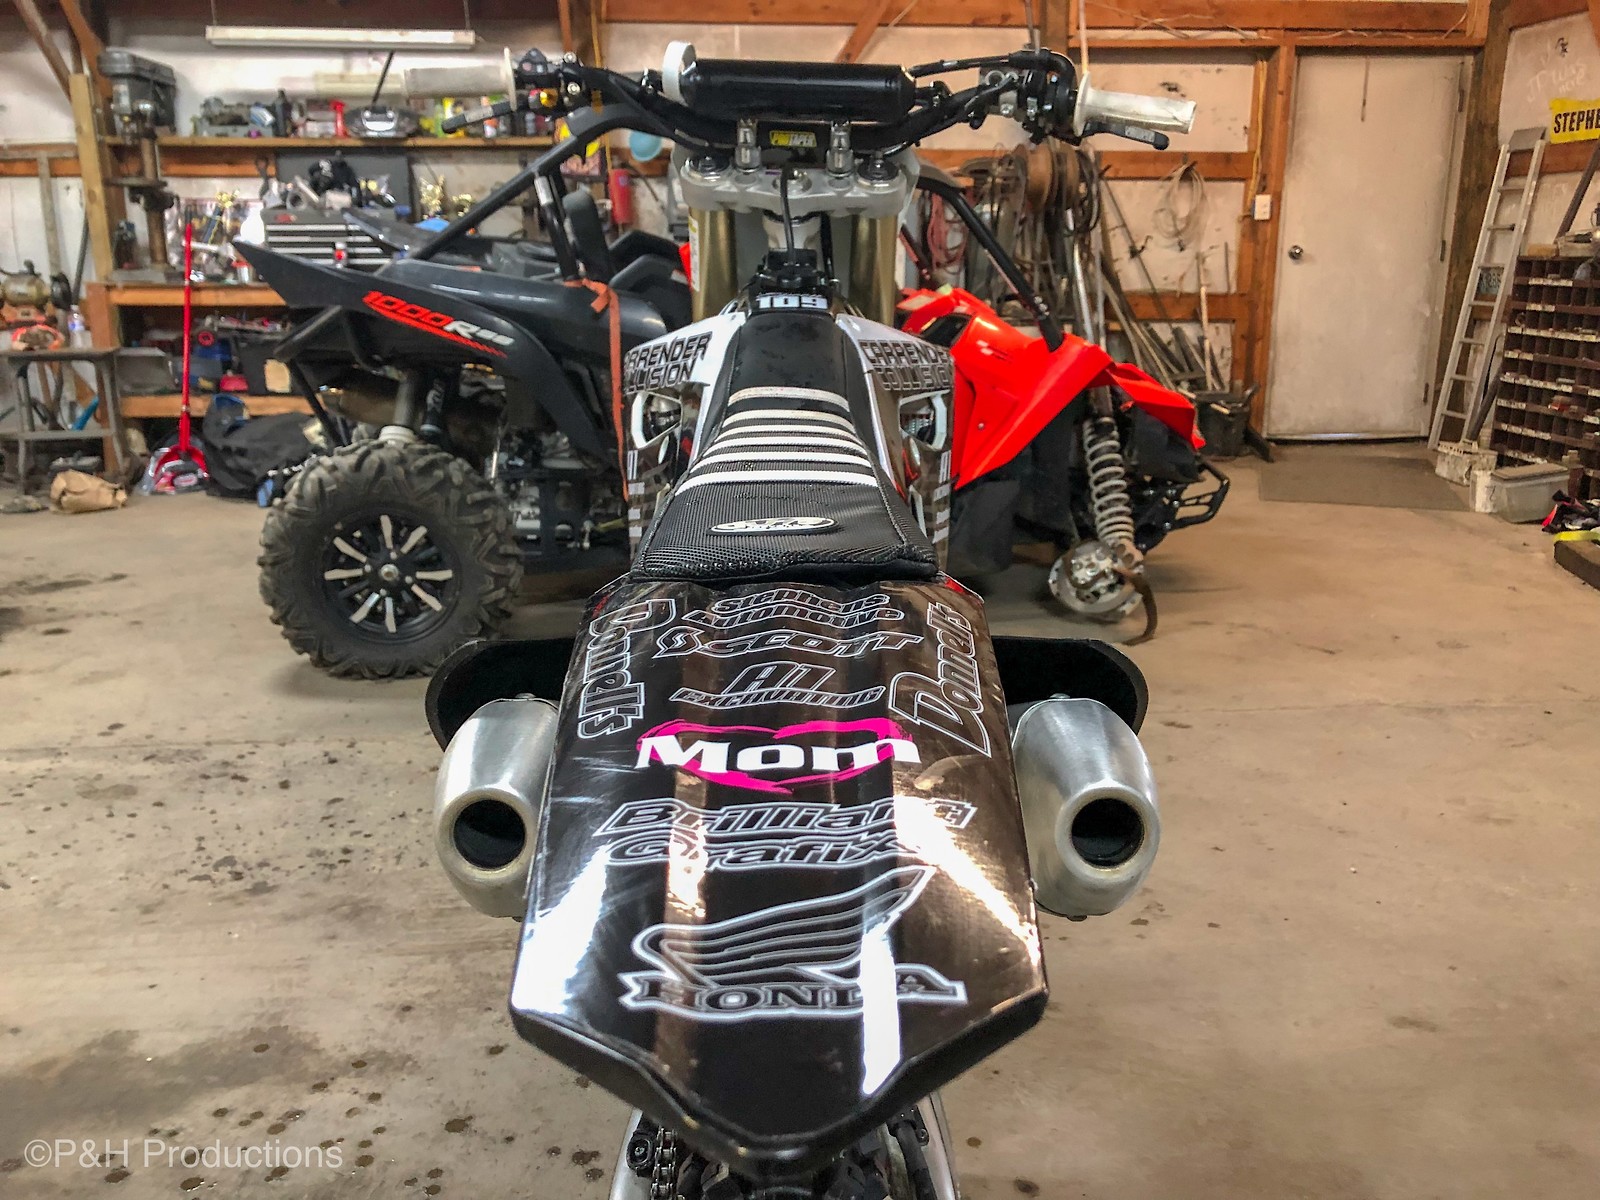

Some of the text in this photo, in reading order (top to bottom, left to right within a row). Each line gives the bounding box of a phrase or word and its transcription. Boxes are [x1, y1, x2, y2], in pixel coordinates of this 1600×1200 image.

[858, 339, 955, 366] CARRENDE
[874, 364, 955, 391] COLLISIO
[696, 629, 925, 658] SCOTT
[634, 735, 922, 774] Mom
[604, 828, 925, 871] Gafix
